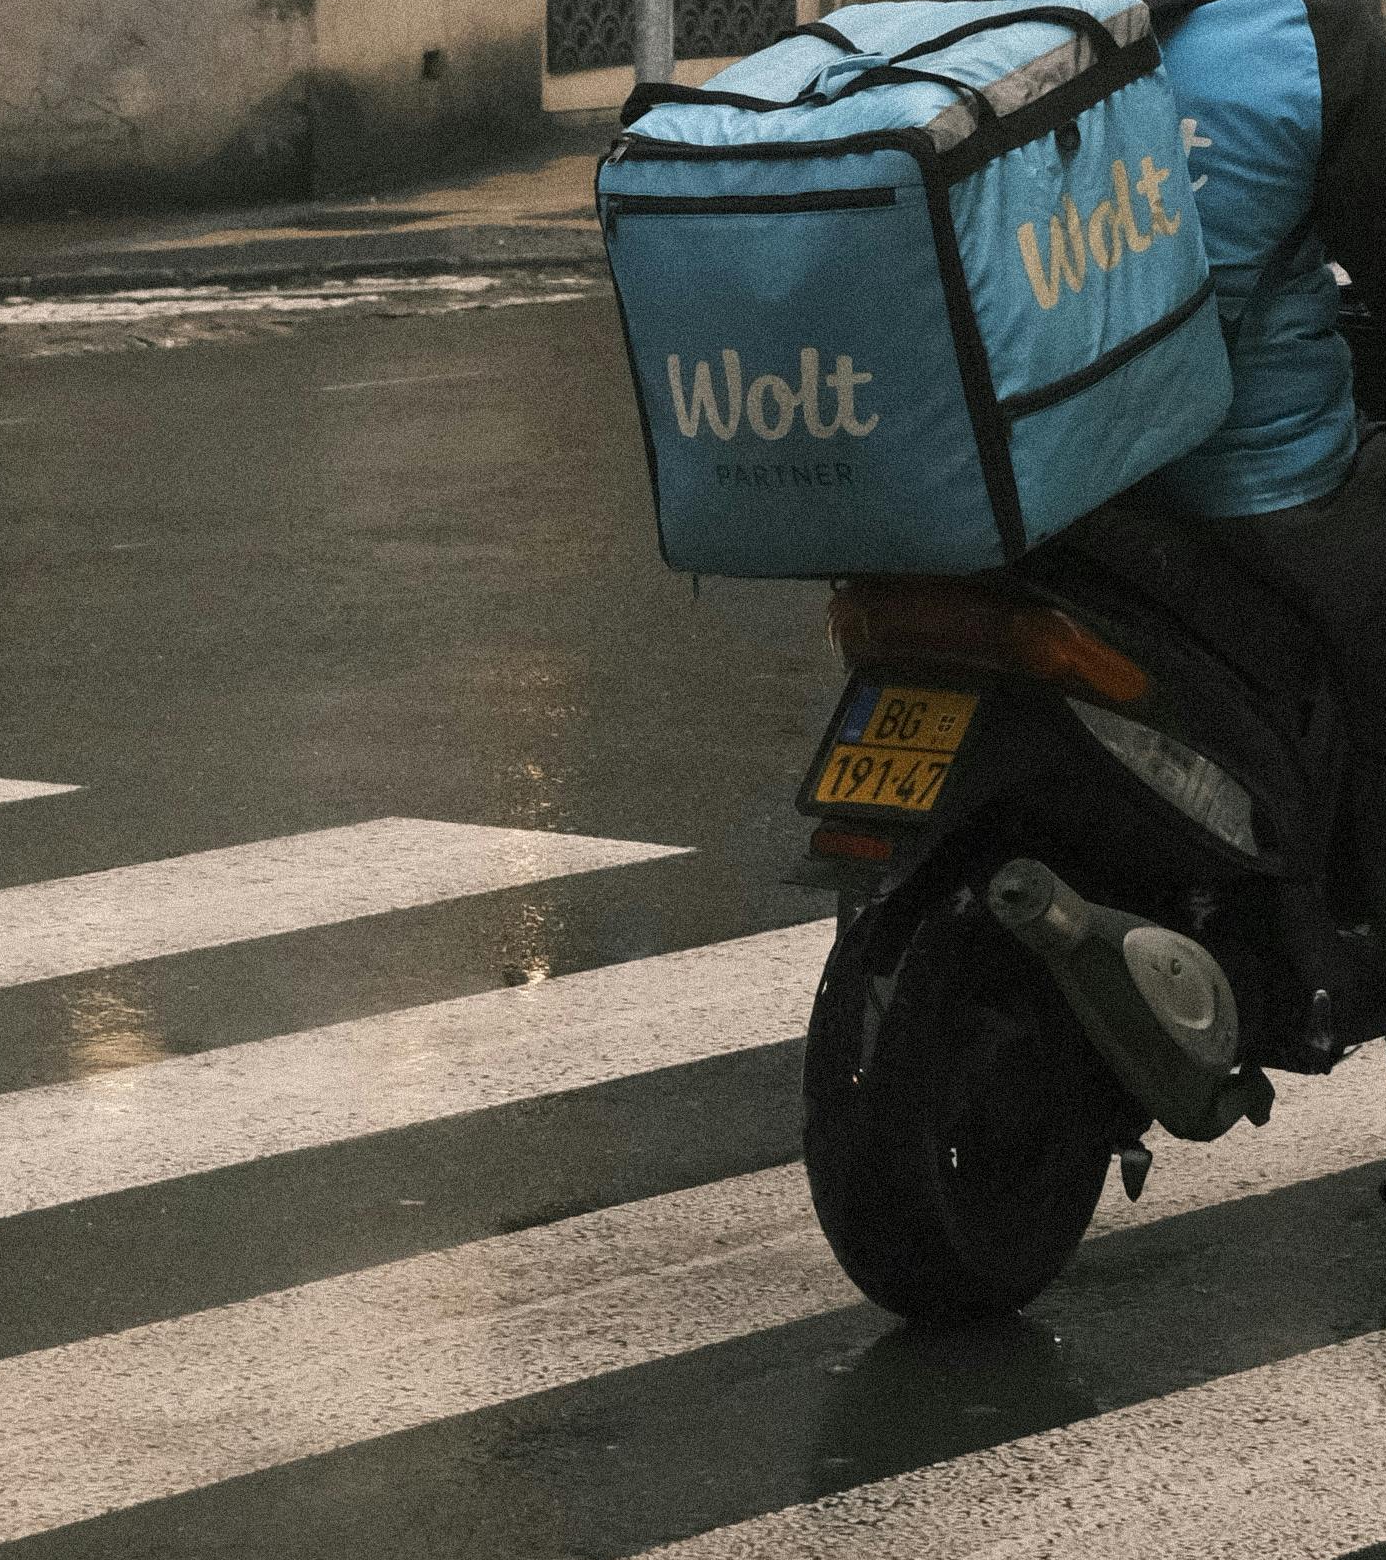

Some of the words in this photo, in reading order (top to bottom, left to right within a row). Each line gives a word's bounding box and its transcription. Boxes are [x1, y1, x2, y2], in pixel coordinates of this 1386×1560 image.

[1016, 155, 1182, 310] Wolt
[666, 345, 880, 440] Wolt
[715, 461, 854, 488] PARTNER
[874, 698, 928, 741] BG
